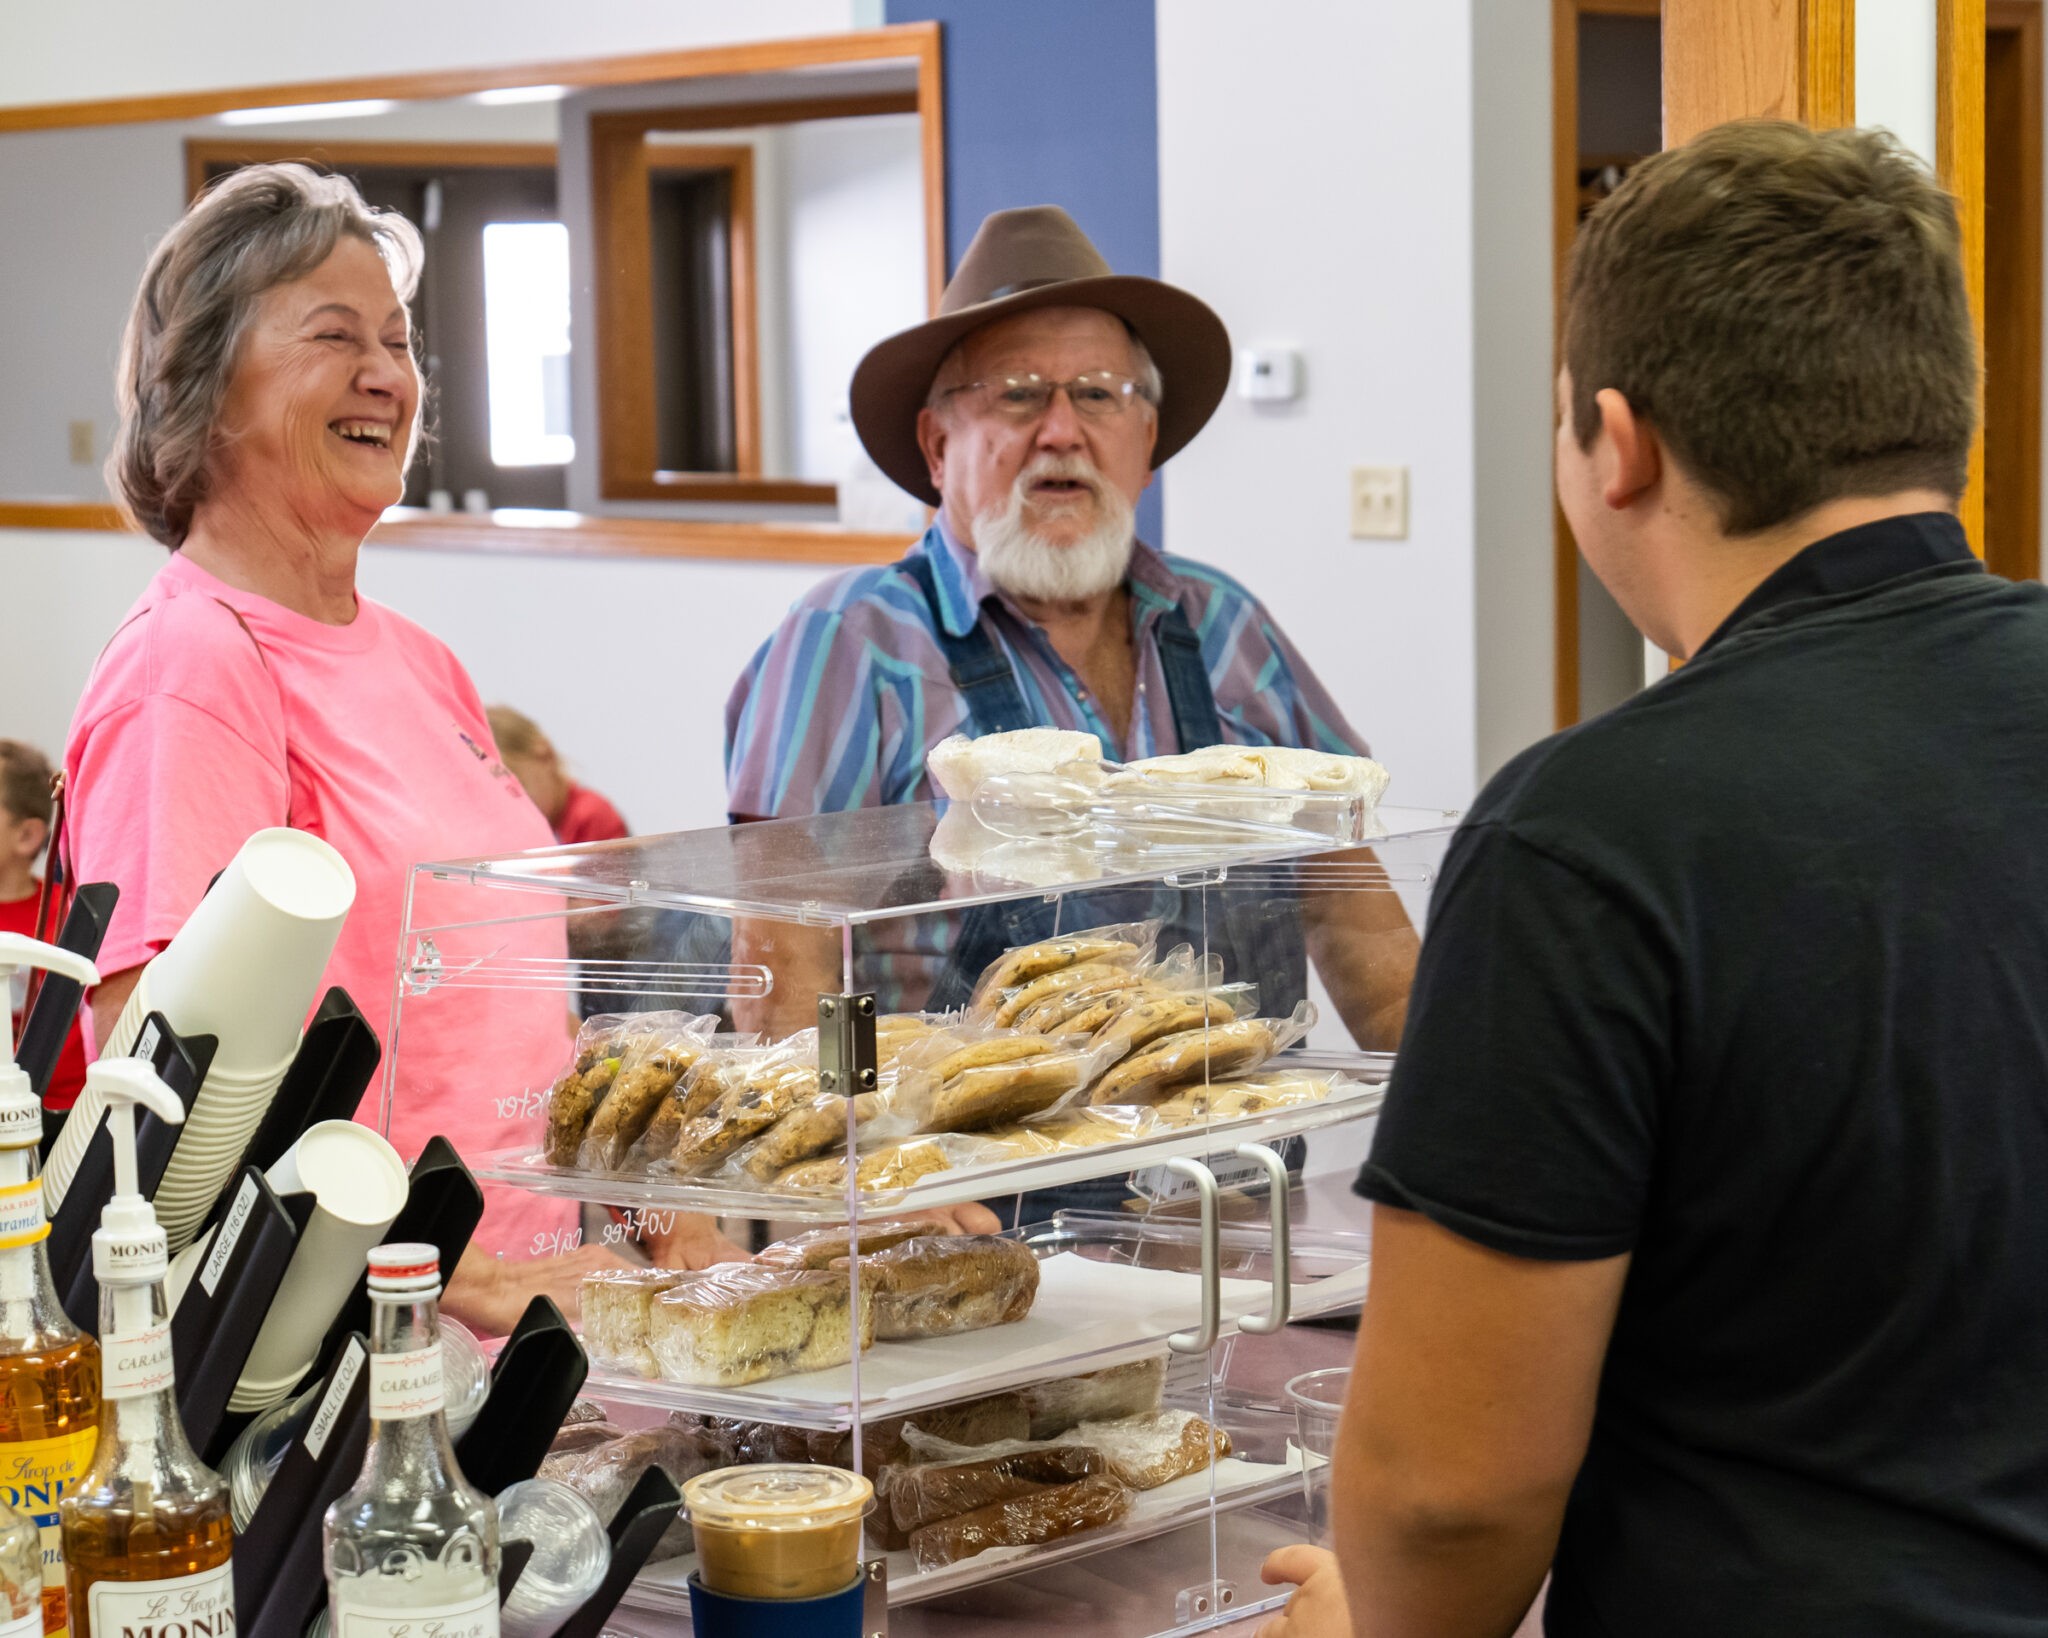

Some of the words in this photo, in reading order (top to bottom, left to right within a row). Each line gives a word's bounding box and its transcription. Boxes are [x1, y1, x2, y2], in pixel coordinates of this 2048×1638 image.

[210, 1233, 231, 1278] LARGE
[227, 1215, 240, 1237] (16
[236, 1192, 250, 1217] OZ)
[314, 1401, 337, 1440] SMALL
[342, 1356, 356, 1380] OZ)
[5, 1457, 55, 1482] Sirop
[138, 1595, 168, 1619] Le
[174, 1590, 216, 1615] Sirop
